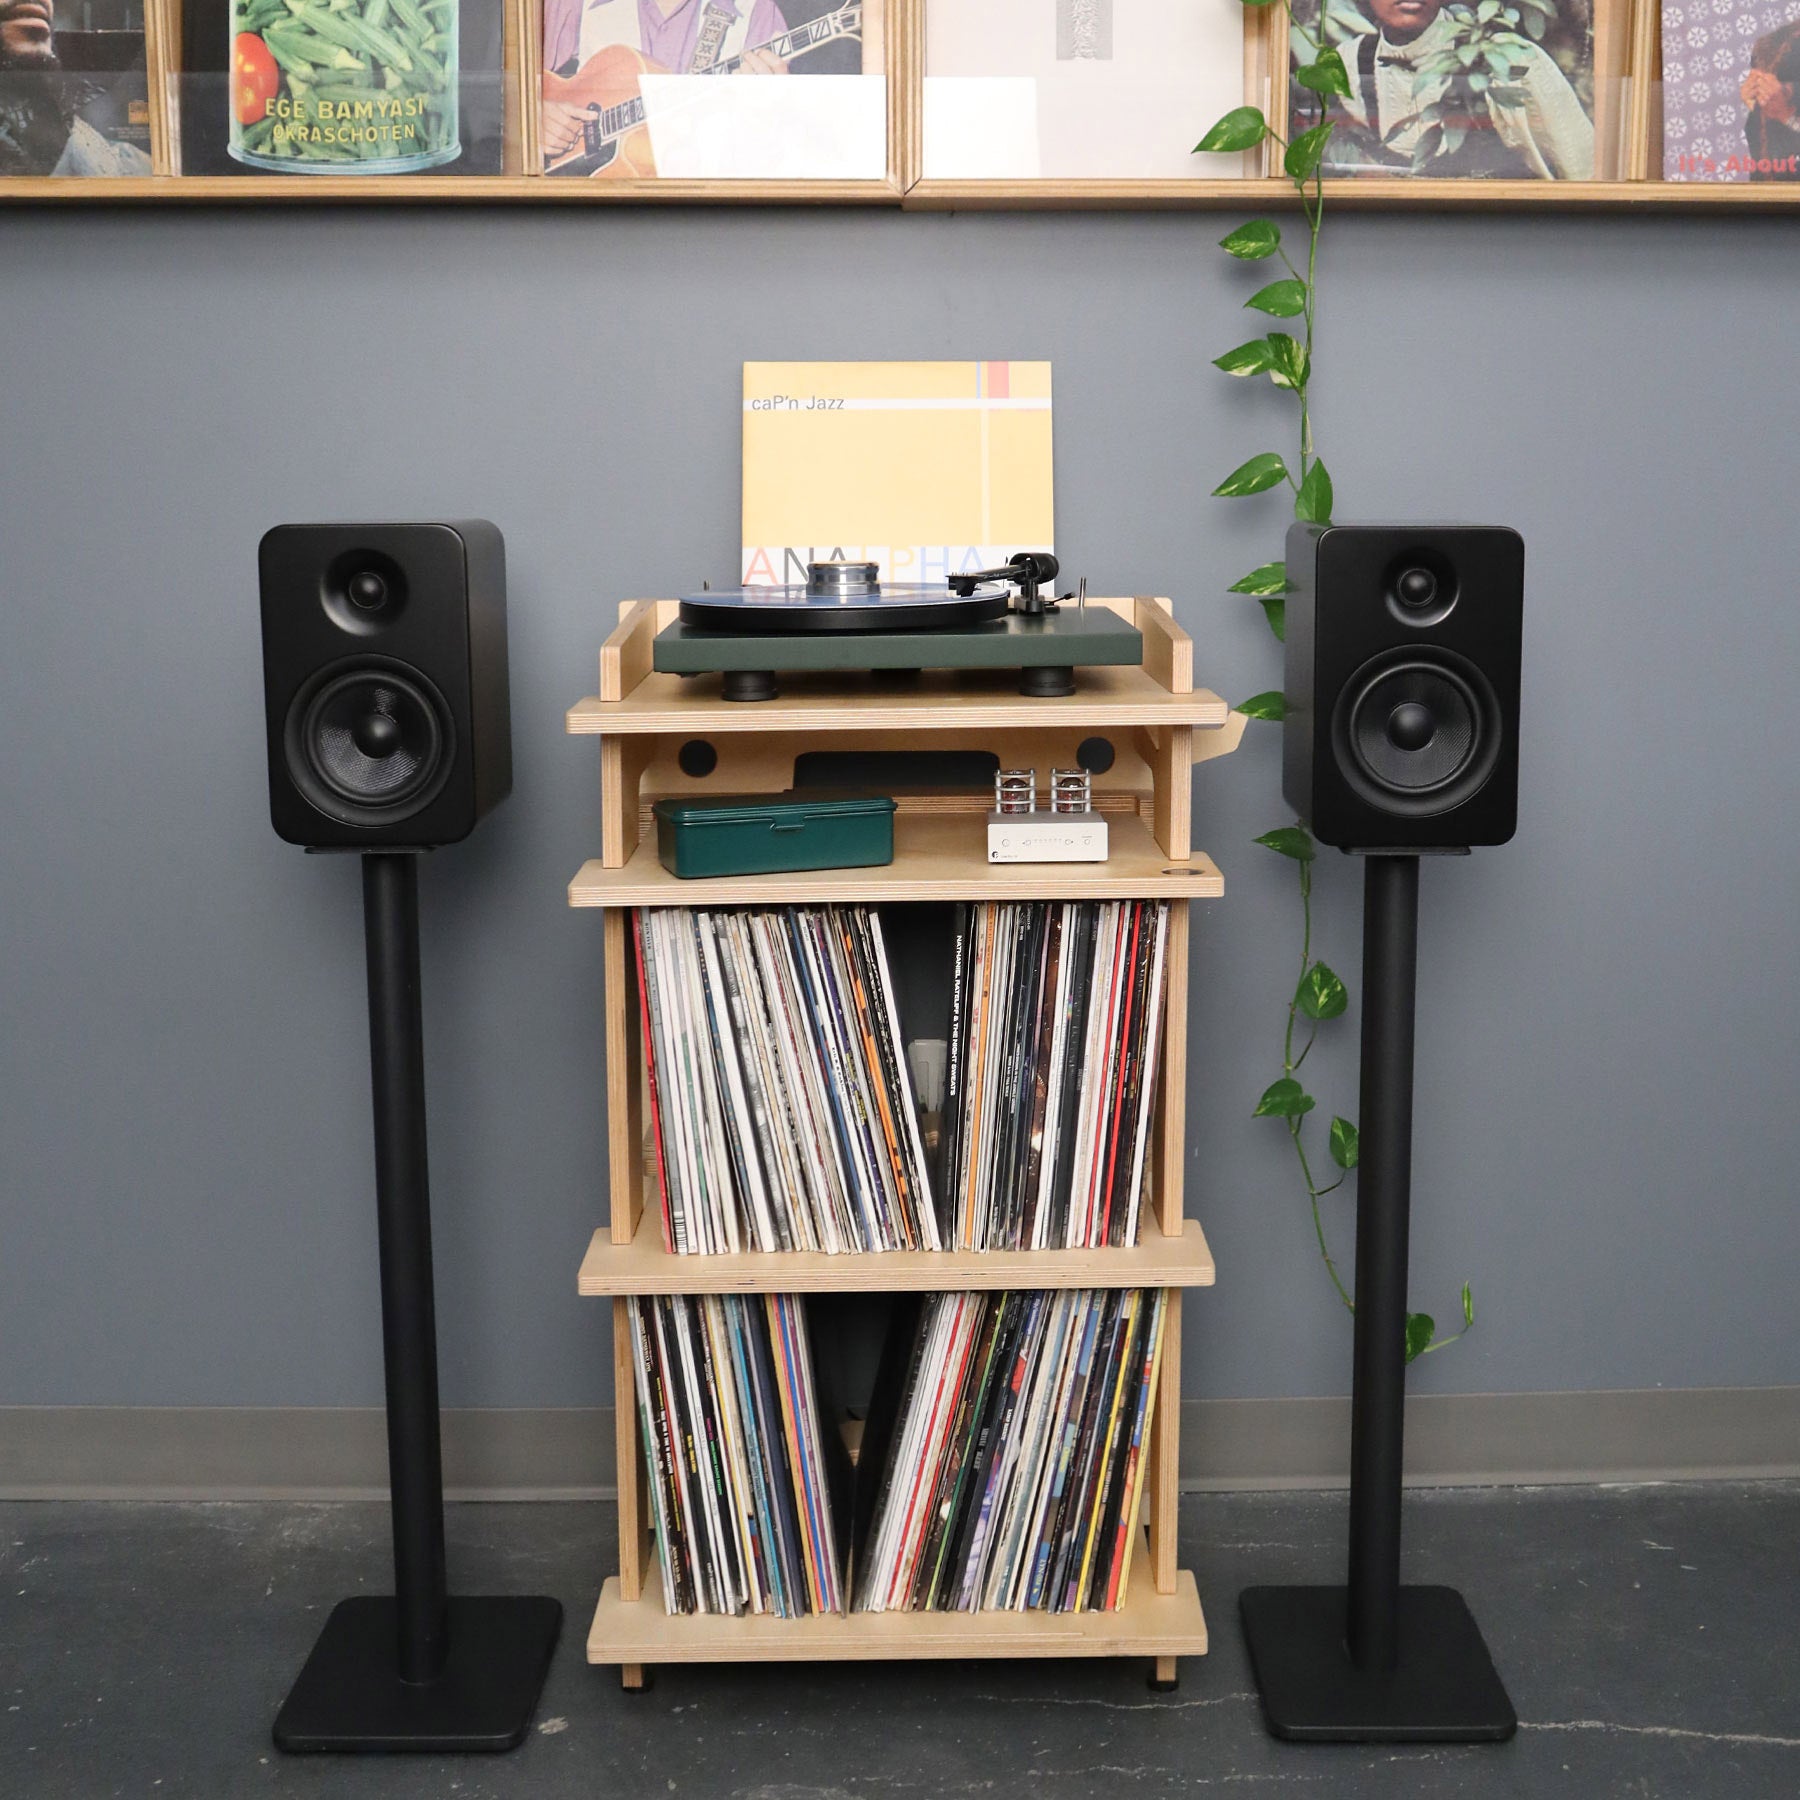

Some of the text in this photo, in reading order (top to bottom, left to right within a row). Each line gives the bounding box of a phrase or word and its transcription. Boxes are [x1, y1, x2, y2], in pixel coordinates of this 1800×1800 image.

[266, 98, 424, 120] EGE BAMYASI
[273, 124, 414, 142] OKRASCHOTEN
[1679, 154, 1797, 173] It's About
[752, 395, 844, 410] caP'n Jazz
